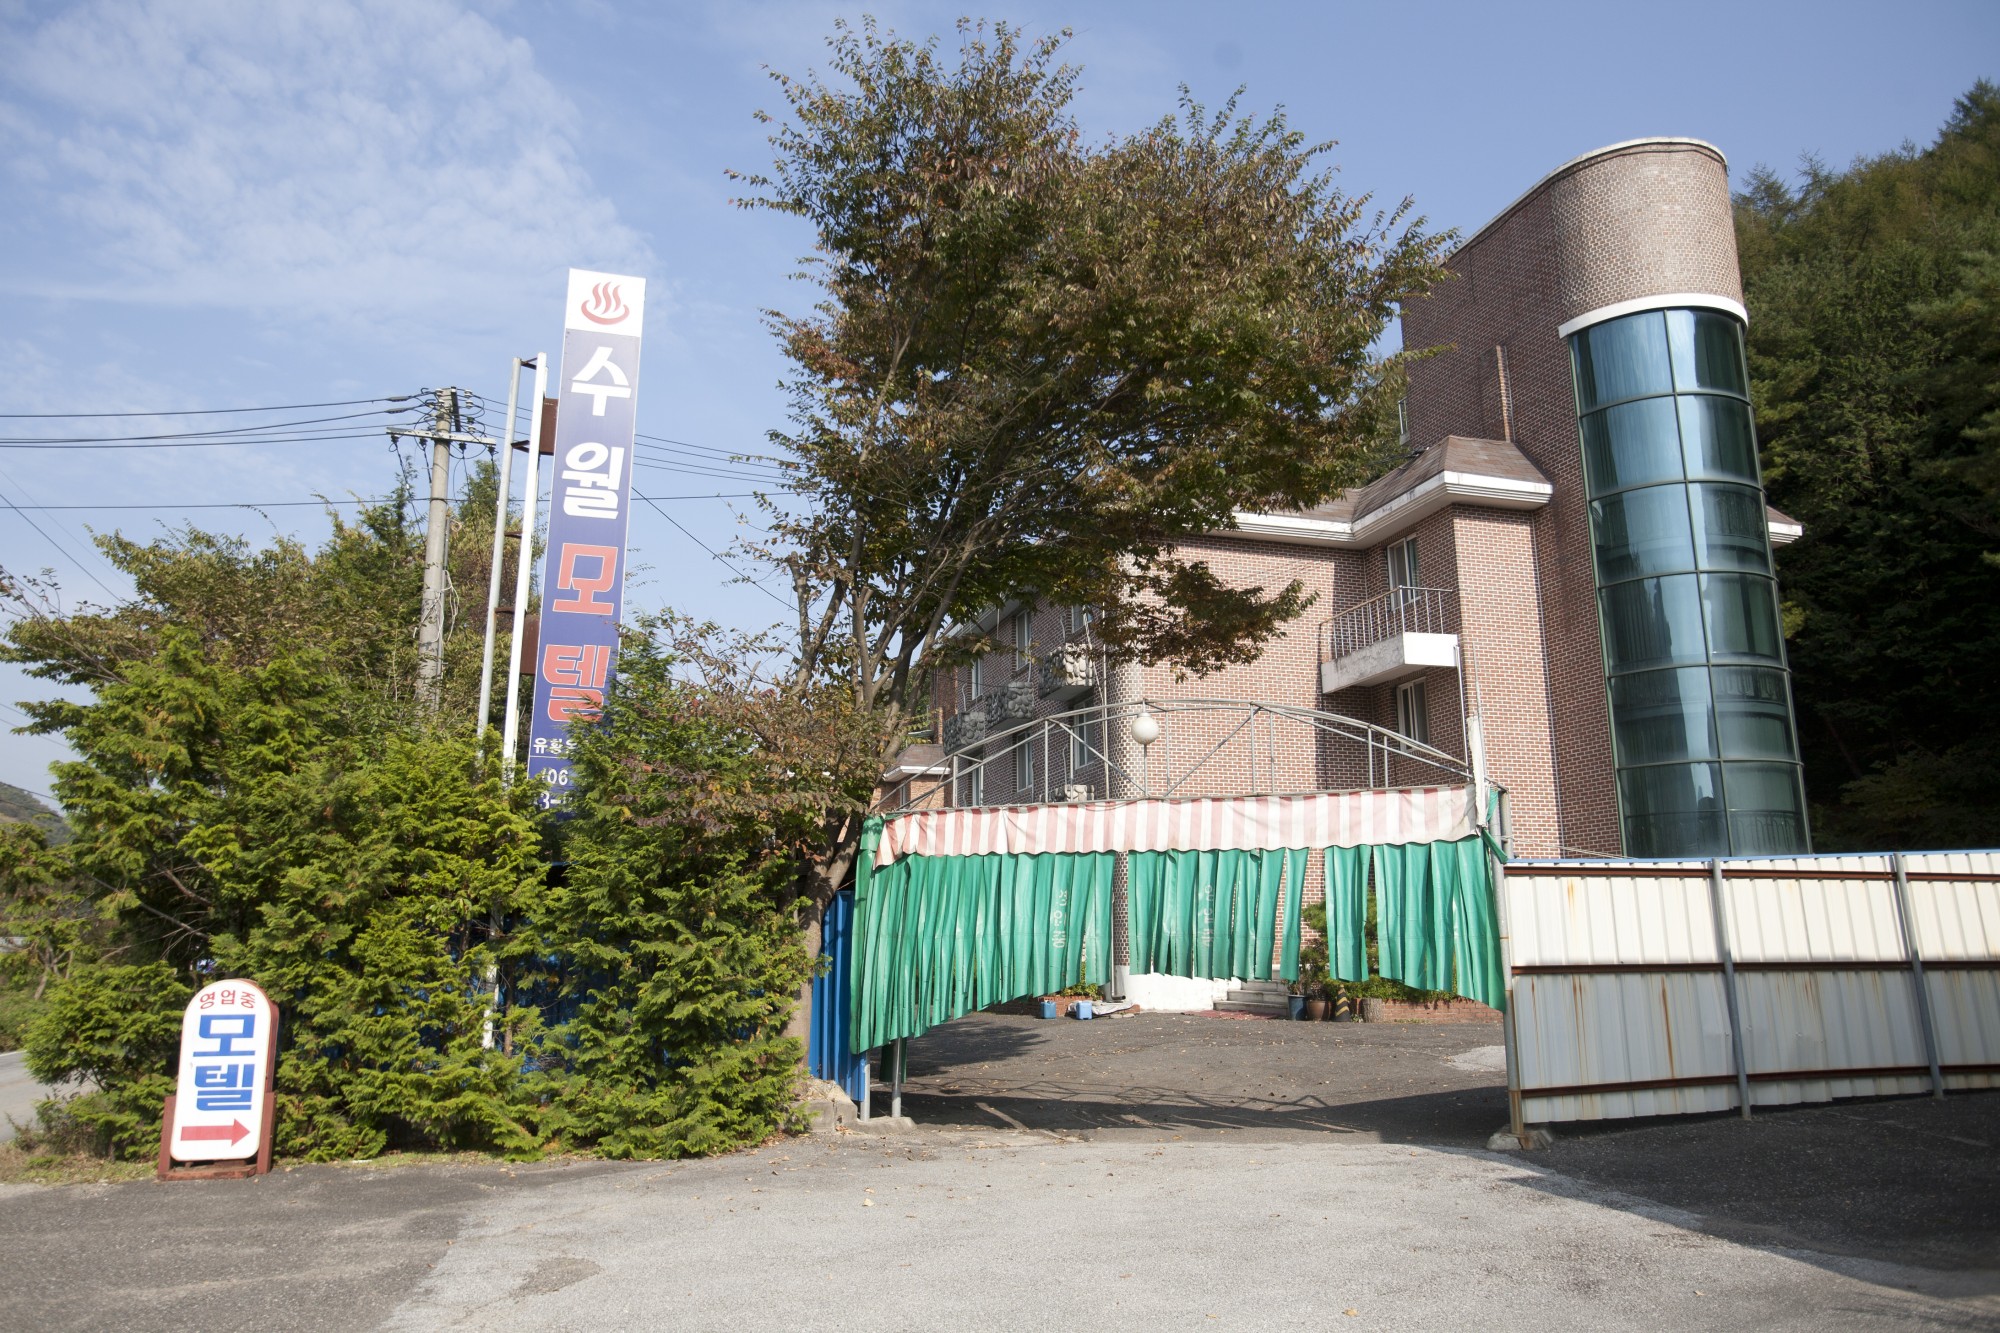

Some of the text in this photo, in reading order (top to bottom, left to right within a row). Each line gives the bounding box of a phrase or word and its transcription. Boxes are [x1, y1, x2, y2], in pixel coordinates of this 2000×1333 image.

[542, 346, 631, 722] 수월 모텔
[200, 989, 256, 1009] 영업중
[193, 1014, 256, 1111] 모텔
